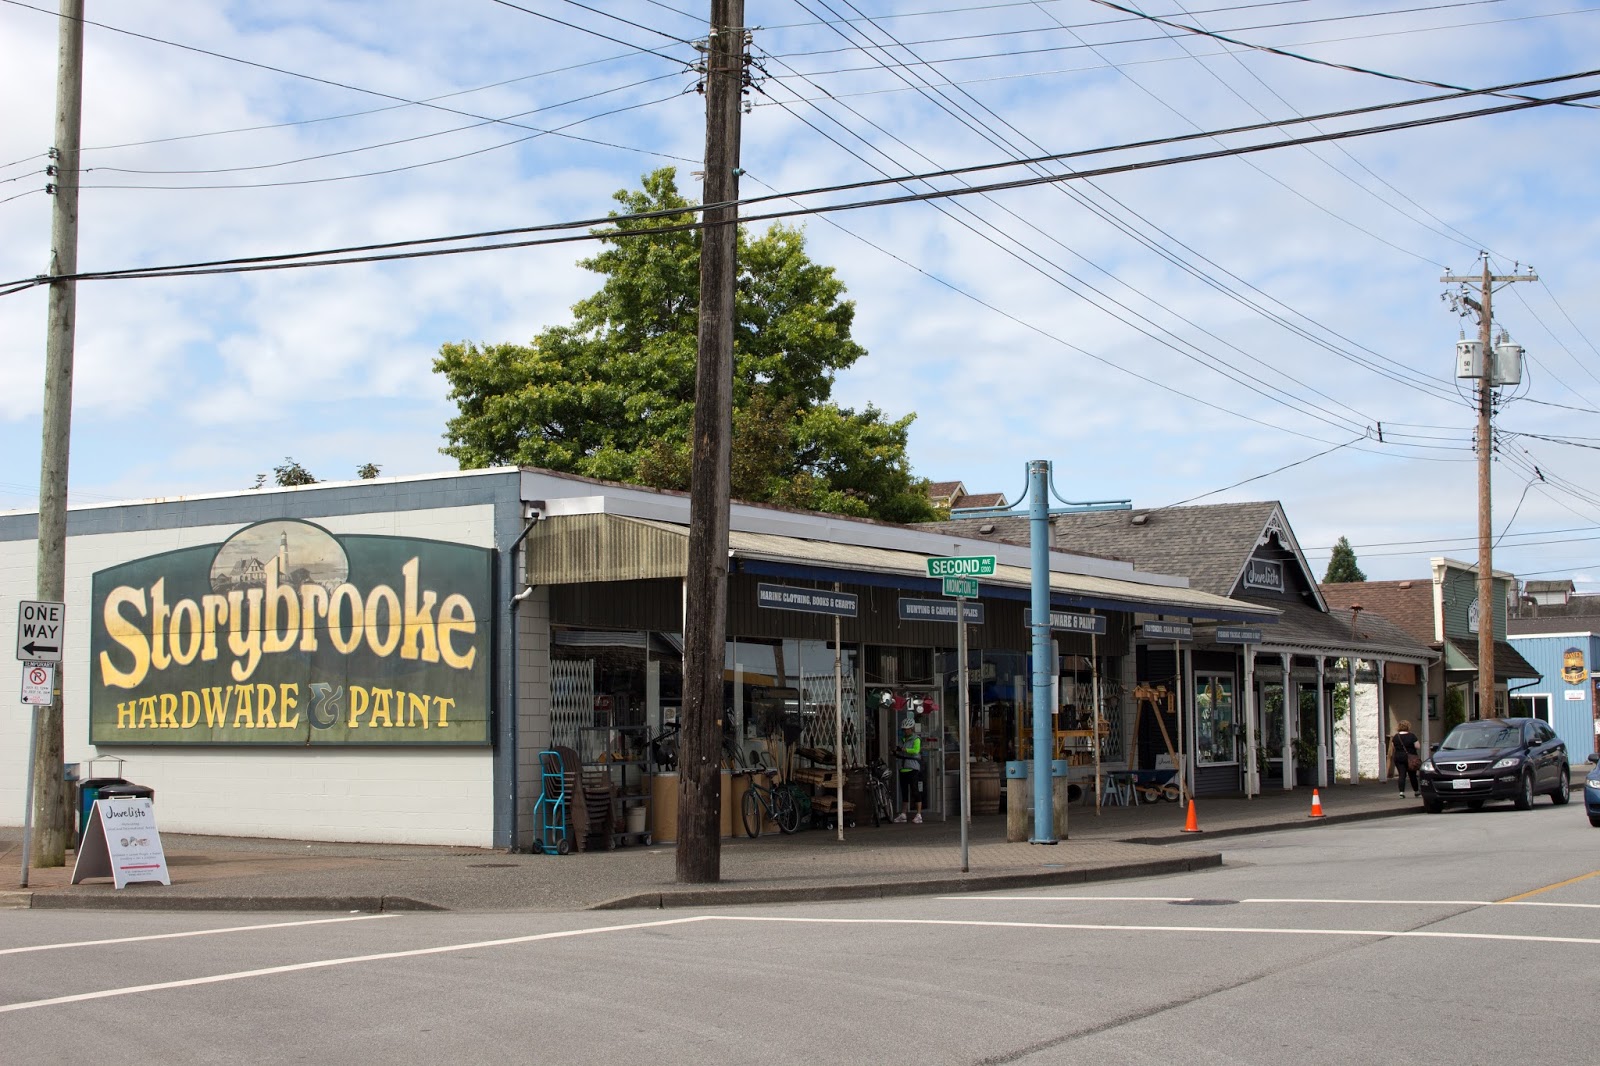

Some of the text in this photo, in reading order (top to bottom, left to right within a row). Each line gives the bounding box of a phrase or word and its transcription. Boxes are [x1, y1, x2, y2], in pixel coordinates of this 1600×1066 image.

[932, 559, 980, 574] SECOND
[760, 590, 782, 602] MARINE
[812, 596, 829, 607] BOOKS
[835, 599, 856, 610] CHARTS
[24, 606, 59, 621] ONE
[906, 604, 931, 615] HUNTING
[100, 555, 476, 688] Storybrooke
[1049, 613, 1072, 628] DWARE
[1079, 616, 1096, 630] PAINT
[24, 623, 59, 639] WAY
[117, 682, 456, 730] HARDWARE & PAINT
[106, 805, 146, 819] Juvelisto
